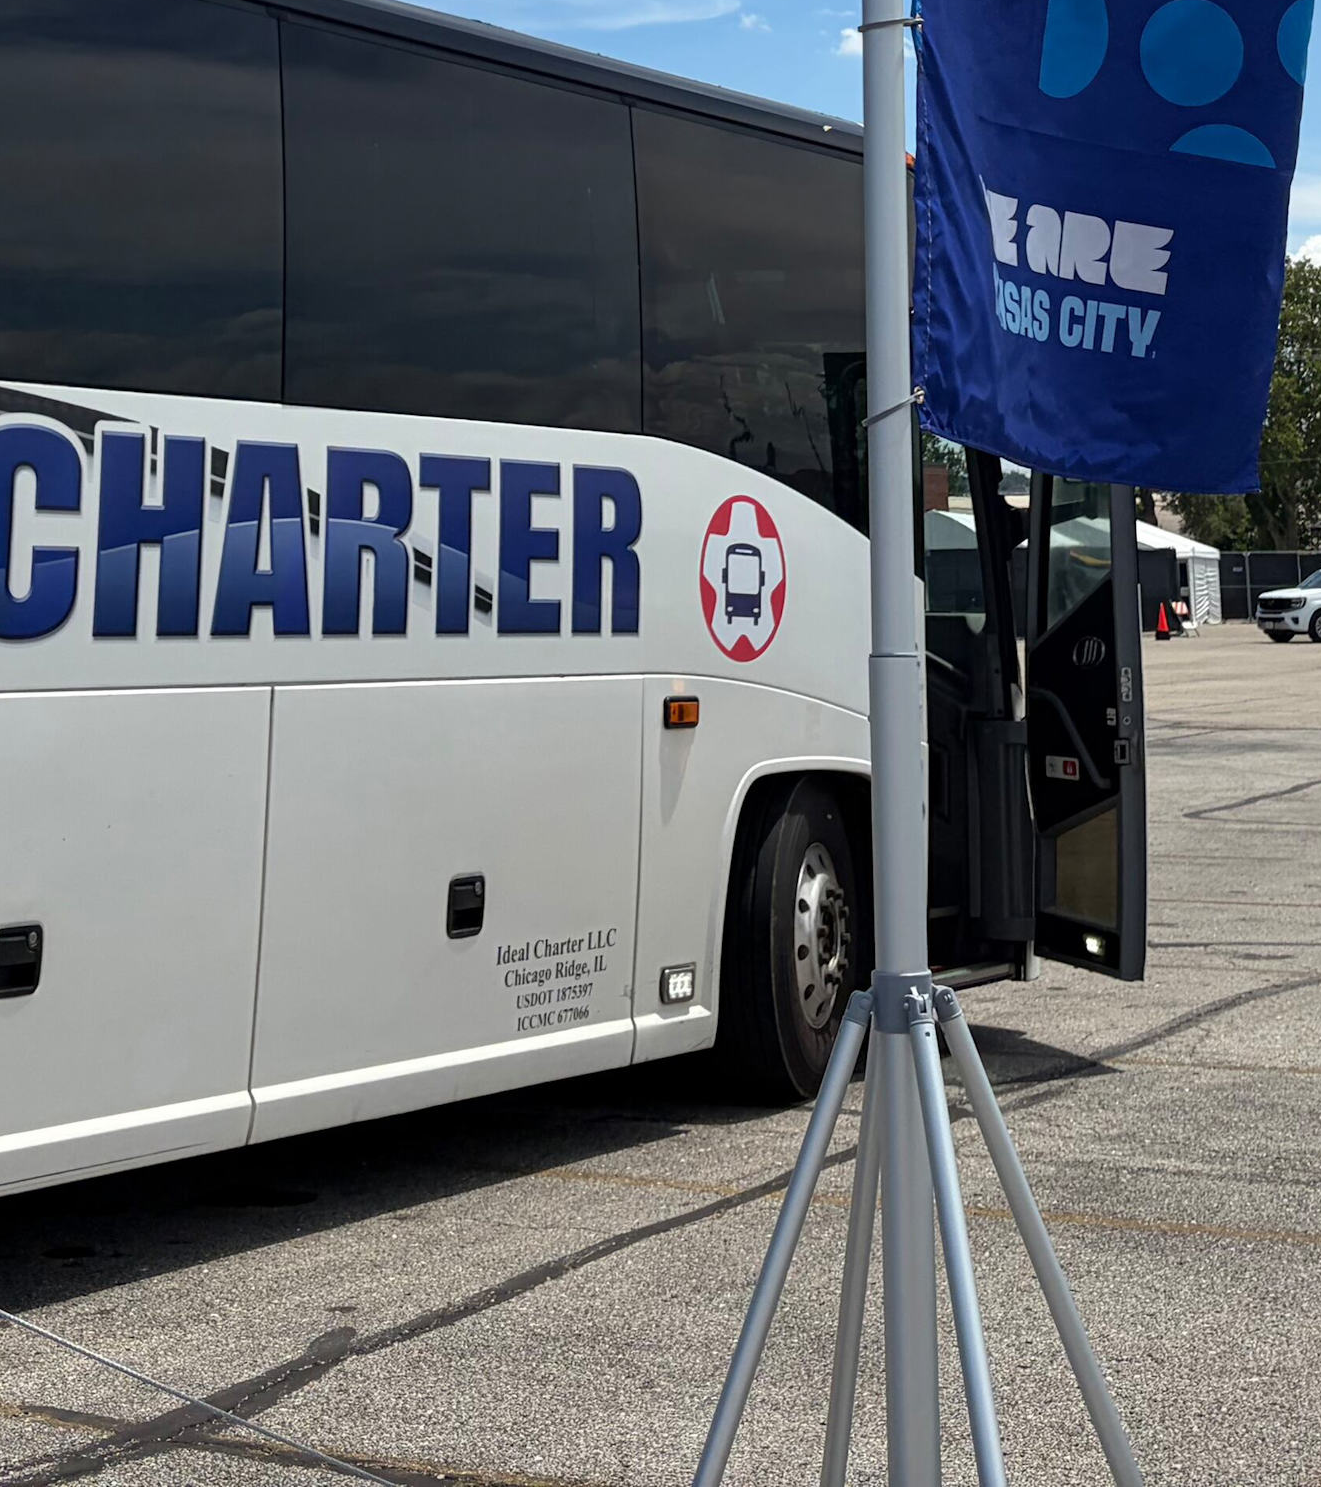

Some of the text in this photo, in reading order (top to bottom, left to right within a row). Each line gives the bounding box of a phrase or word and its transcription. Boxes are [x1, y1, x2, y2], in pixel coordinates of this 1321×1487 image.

[979, 174, 1019, 267] E
[1059, 295, 1162, 359] CITY
[496, 928, 617, 966] Ideal Charter LLC
[504, 955, 607, 987] Chicago Ridge, IL
[516, 983, 593, 1009] USDOT 1875397
[517, 1005, 589, 1031] ICCMC 677066
